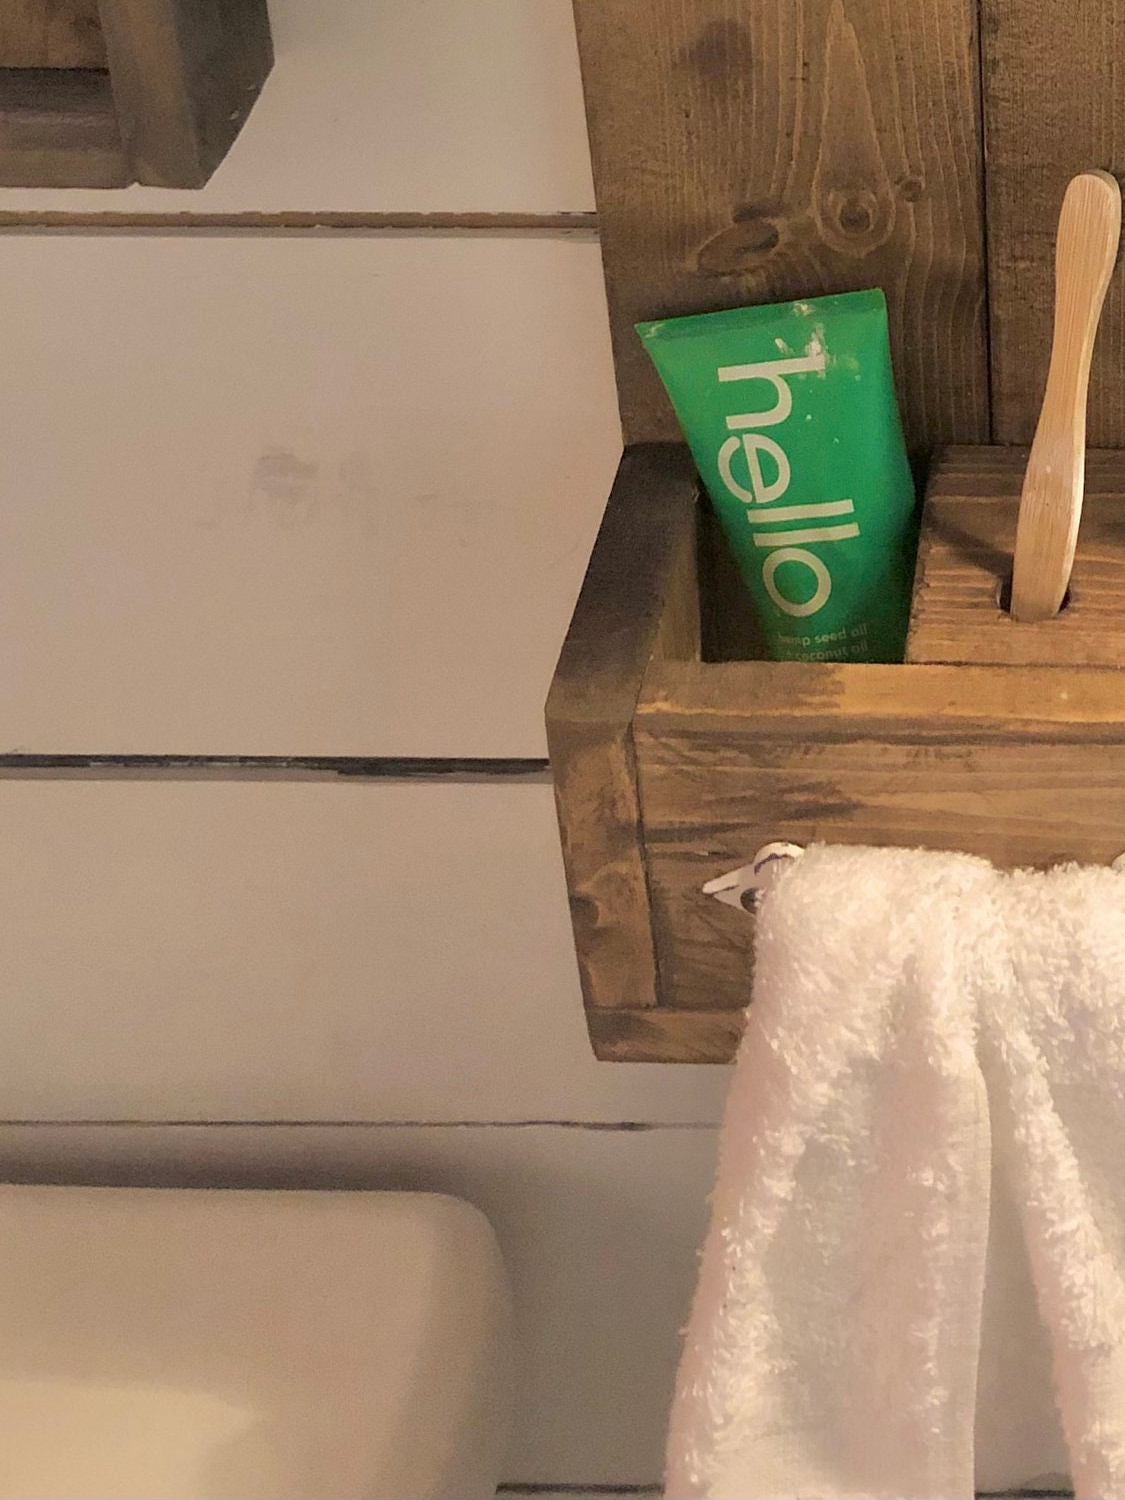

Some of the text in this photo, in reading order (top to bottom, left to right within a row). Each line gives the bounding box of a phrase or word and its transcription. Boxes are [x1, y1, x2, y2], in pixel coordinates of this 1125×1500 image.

[717, 354, 860, 618] hello
[814, 627, 847, 644] seed
[850, 622, 868, 638] oil
[851, 640, 868, 654] oil
